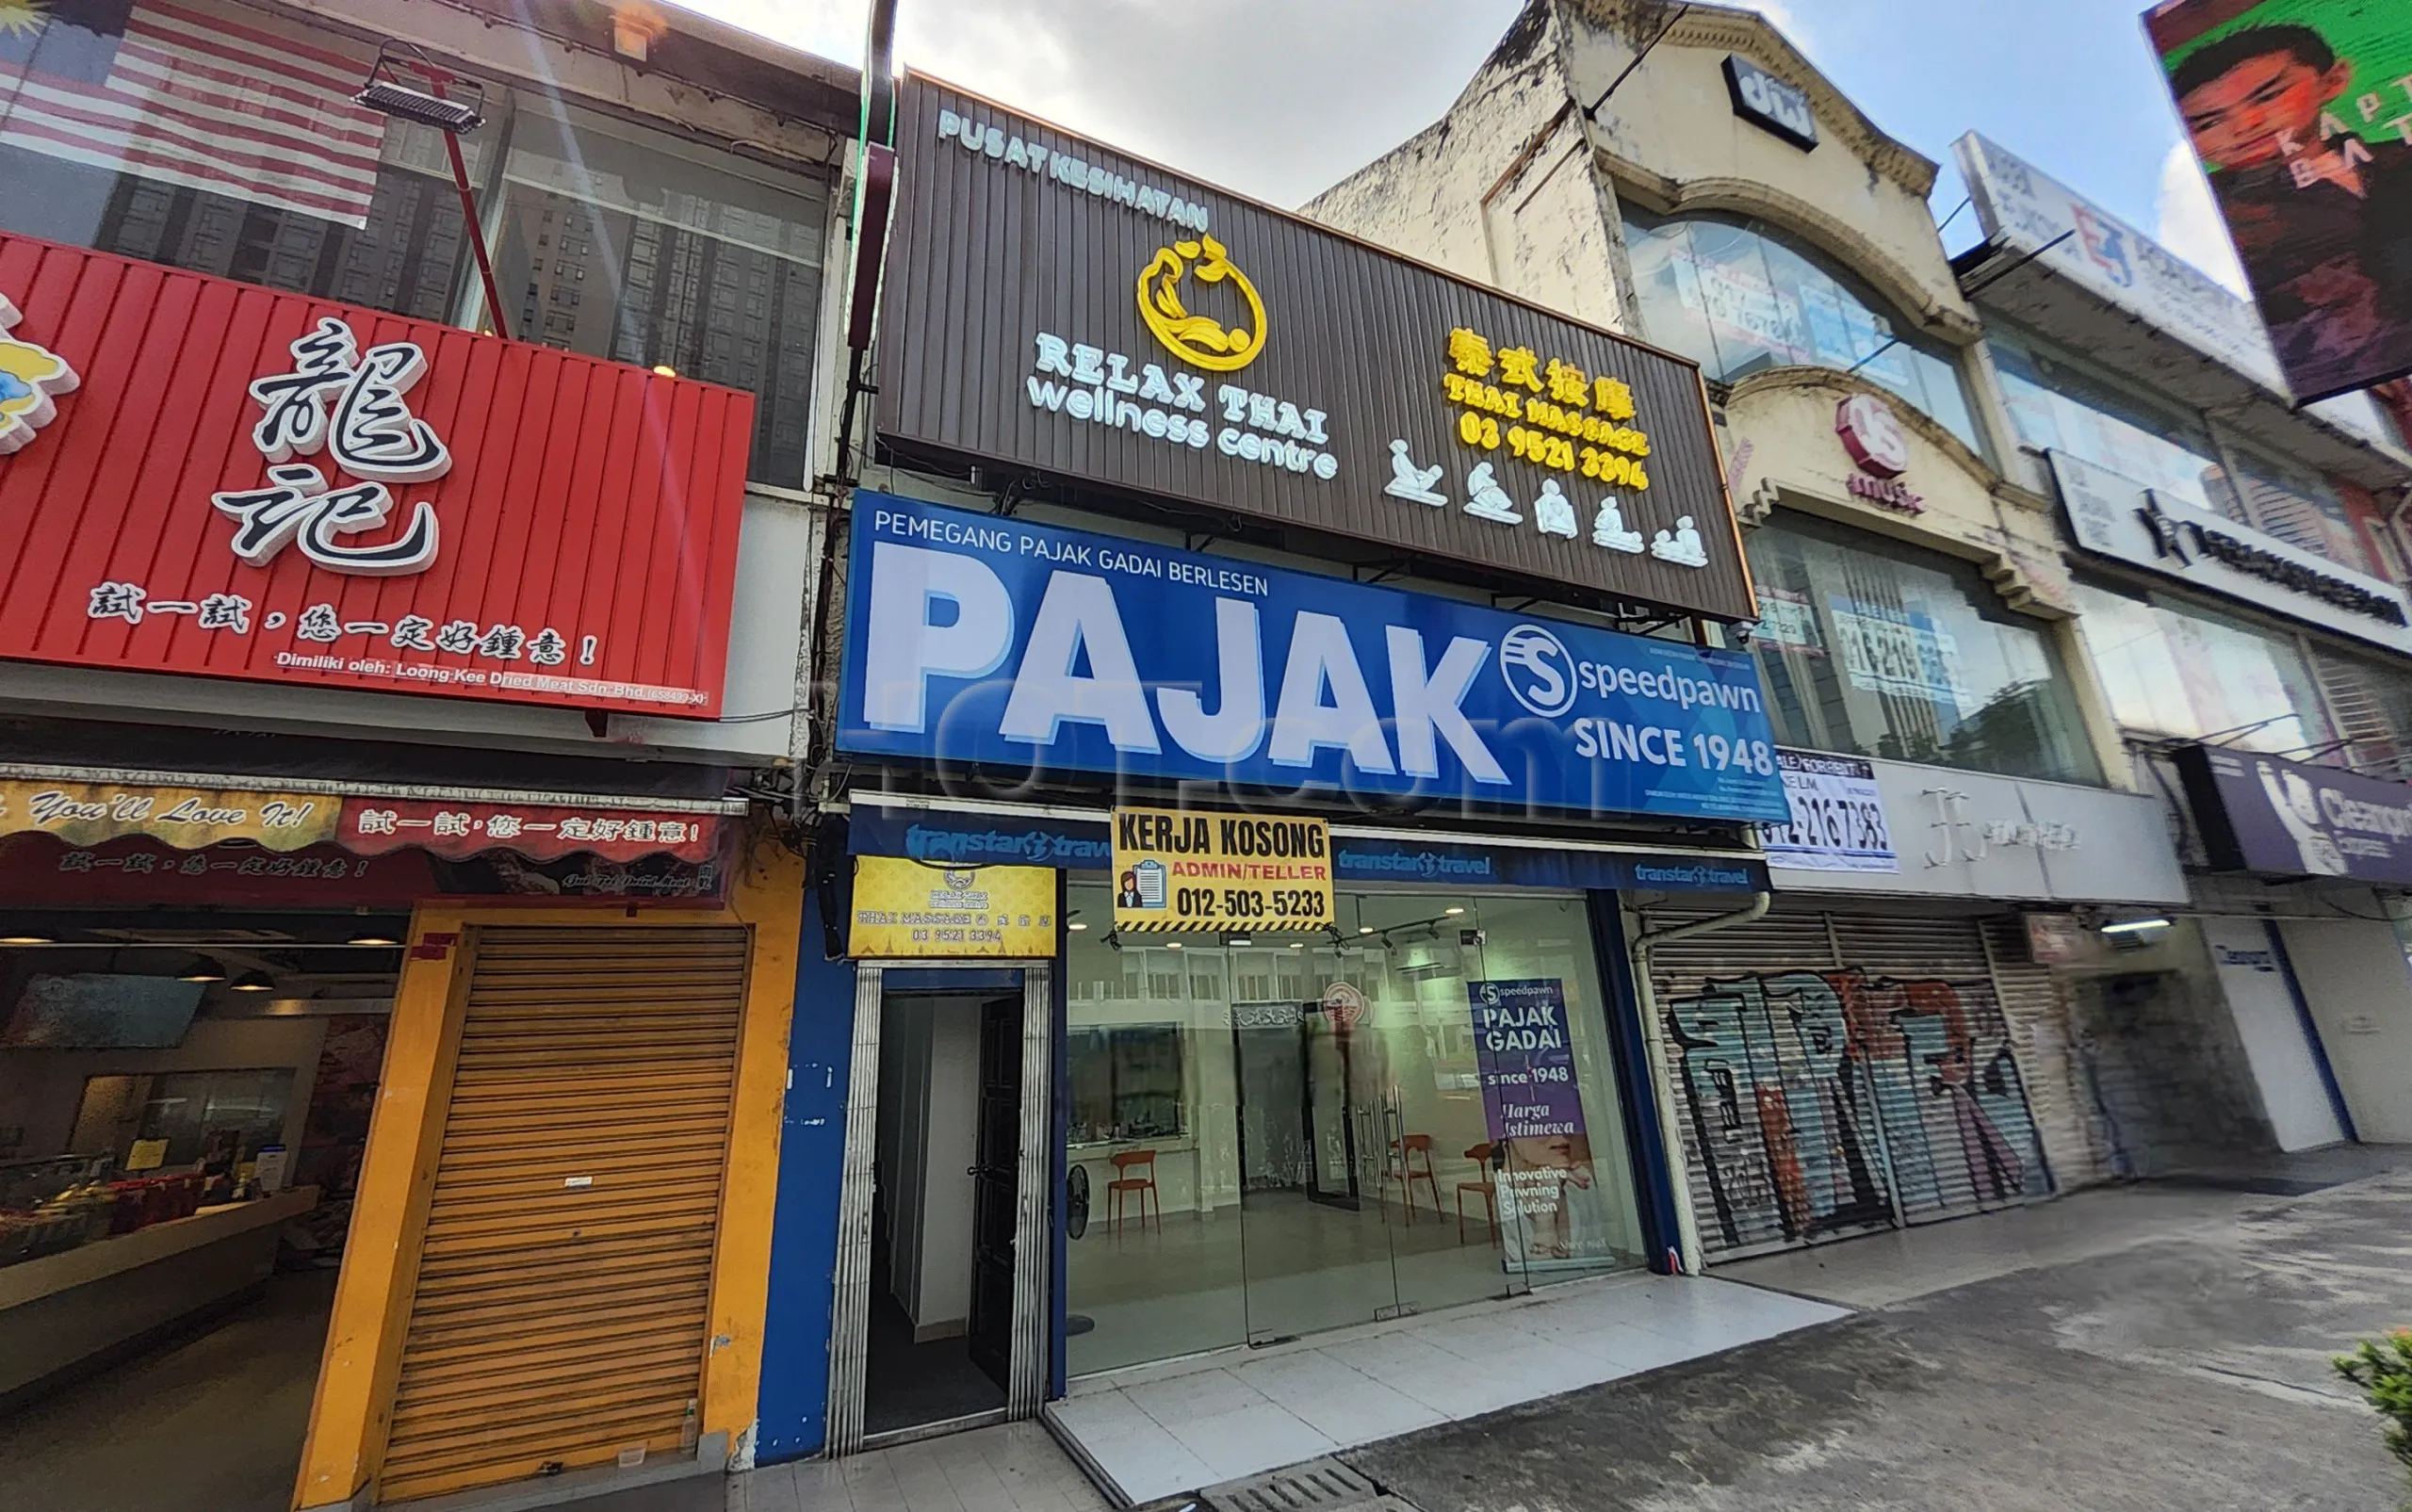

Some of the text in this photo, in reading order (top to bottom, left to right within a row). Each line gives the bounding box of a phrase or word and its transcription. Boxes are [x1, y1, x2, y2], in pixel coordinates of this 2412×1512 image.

[938, 109, 1209, 234] PUSAT KESIHATAN
[1035, 332, 1329, 446] RELAX THAI
[1447, 326, 1637, 421] 泰式按摩
[1026, 375, 1339, 480] wellness centre
[1443, 373, 1651, 457] THAI MASSAGE
[212, 317, 452, 577] 龍記
[1459, 411, 1650, 492] 03 9521 3394
[874, 510, 1268, 597] PEMEGANG PAJAK GADAI BERLESEN
[276, 652, 344, 671] Dimiliki
[349, 658, 391, 675] oleh:
[453, 669, 486, 685] Kee
[490, 672, 532, 689] Dried
[536, 677, 575, 692] Meat
[863, 541, 1512, 785] PAJAK
[1578, 658, 1761, 714] speedpawn
[1574, 718, 1774, 777] SINCE 1948
[29, 790, 316, 829] You'll Love It!
[1054, 835, 1111, 857] trav
[1118, 813, 1326, 859] KERJA KOSONG
[1171, 860, 1327, 882] ADMIN/TELLER
[1338, 849, 1491, 876] transtar travel
[1635, 861, 1750, 886] transtar travel
[857, 911, 971, 925] THAI MASSAGE
[1177, 888, 1325, 919] 012-503-5233
[912, 930, 1002, 942] 03 9521 3394
[1500, 984, 1554, 997] speedpawn
[1483, 1005, 1558, 1029] PAJAK
[1486, 1029, 1562, 1052] GADAI
[1531, 1065, 1569, 1083] 1948
[1503, 1120, 1574, 1138] Istimewa
[1497, 1166, 1568, 1183] Innovative
[1503, 1199, 1558, 1215] Slution
